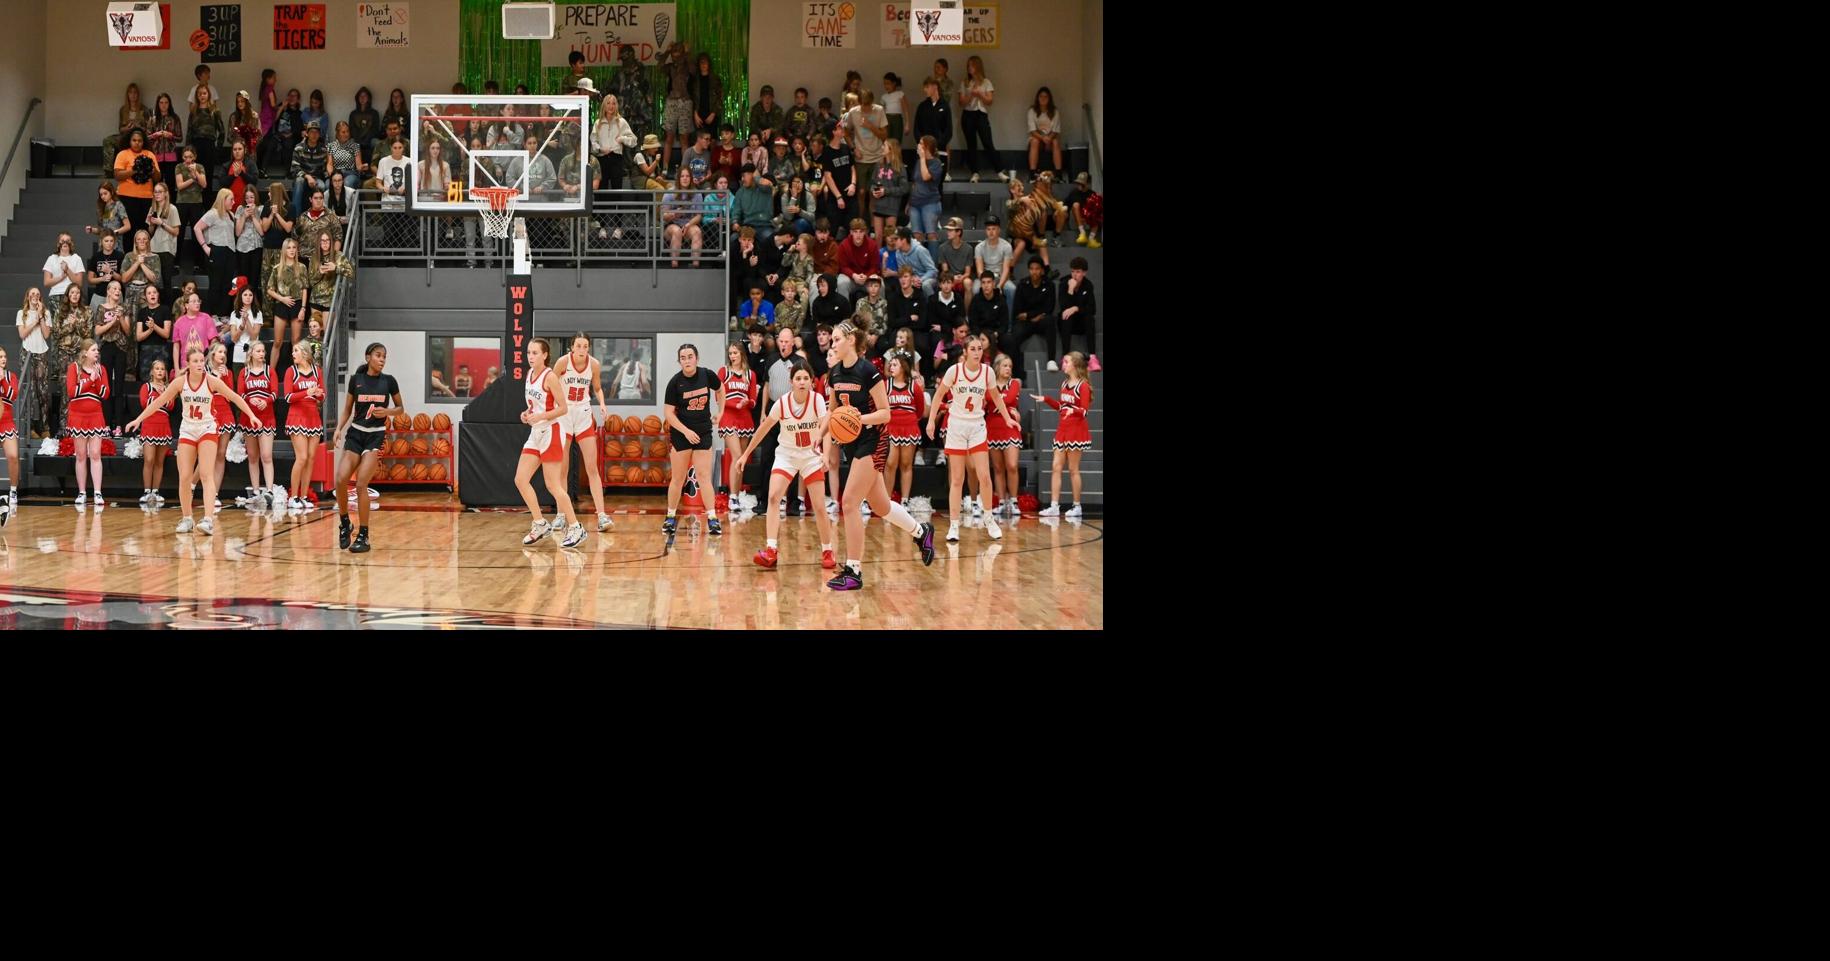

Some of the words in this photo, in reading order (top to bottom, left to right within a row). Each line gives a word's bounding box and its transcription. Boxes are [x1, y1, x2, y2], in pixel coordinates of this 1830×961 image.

[274, 6, 307, 19] TRAP
[565, 5, 640, 26] PREPARE
[809, 3, 835, 16] ITS
[374, 15, 392, 25] Feed
[806, 16, 848, 35] GAME
[273, 29, 325, 49] TIGERS
[374, 32, 408, 45] Animals
[575, 31, 591, 45] To
[808, 35, 842, 47] TIME
[963, 27, 995, 44] GERS
[510, 286, 527, 381] WOLVES
[567, 386, 585, 401] 55
[965, 396, 974, 412] 4
[189, 405, 203, 420] 14
